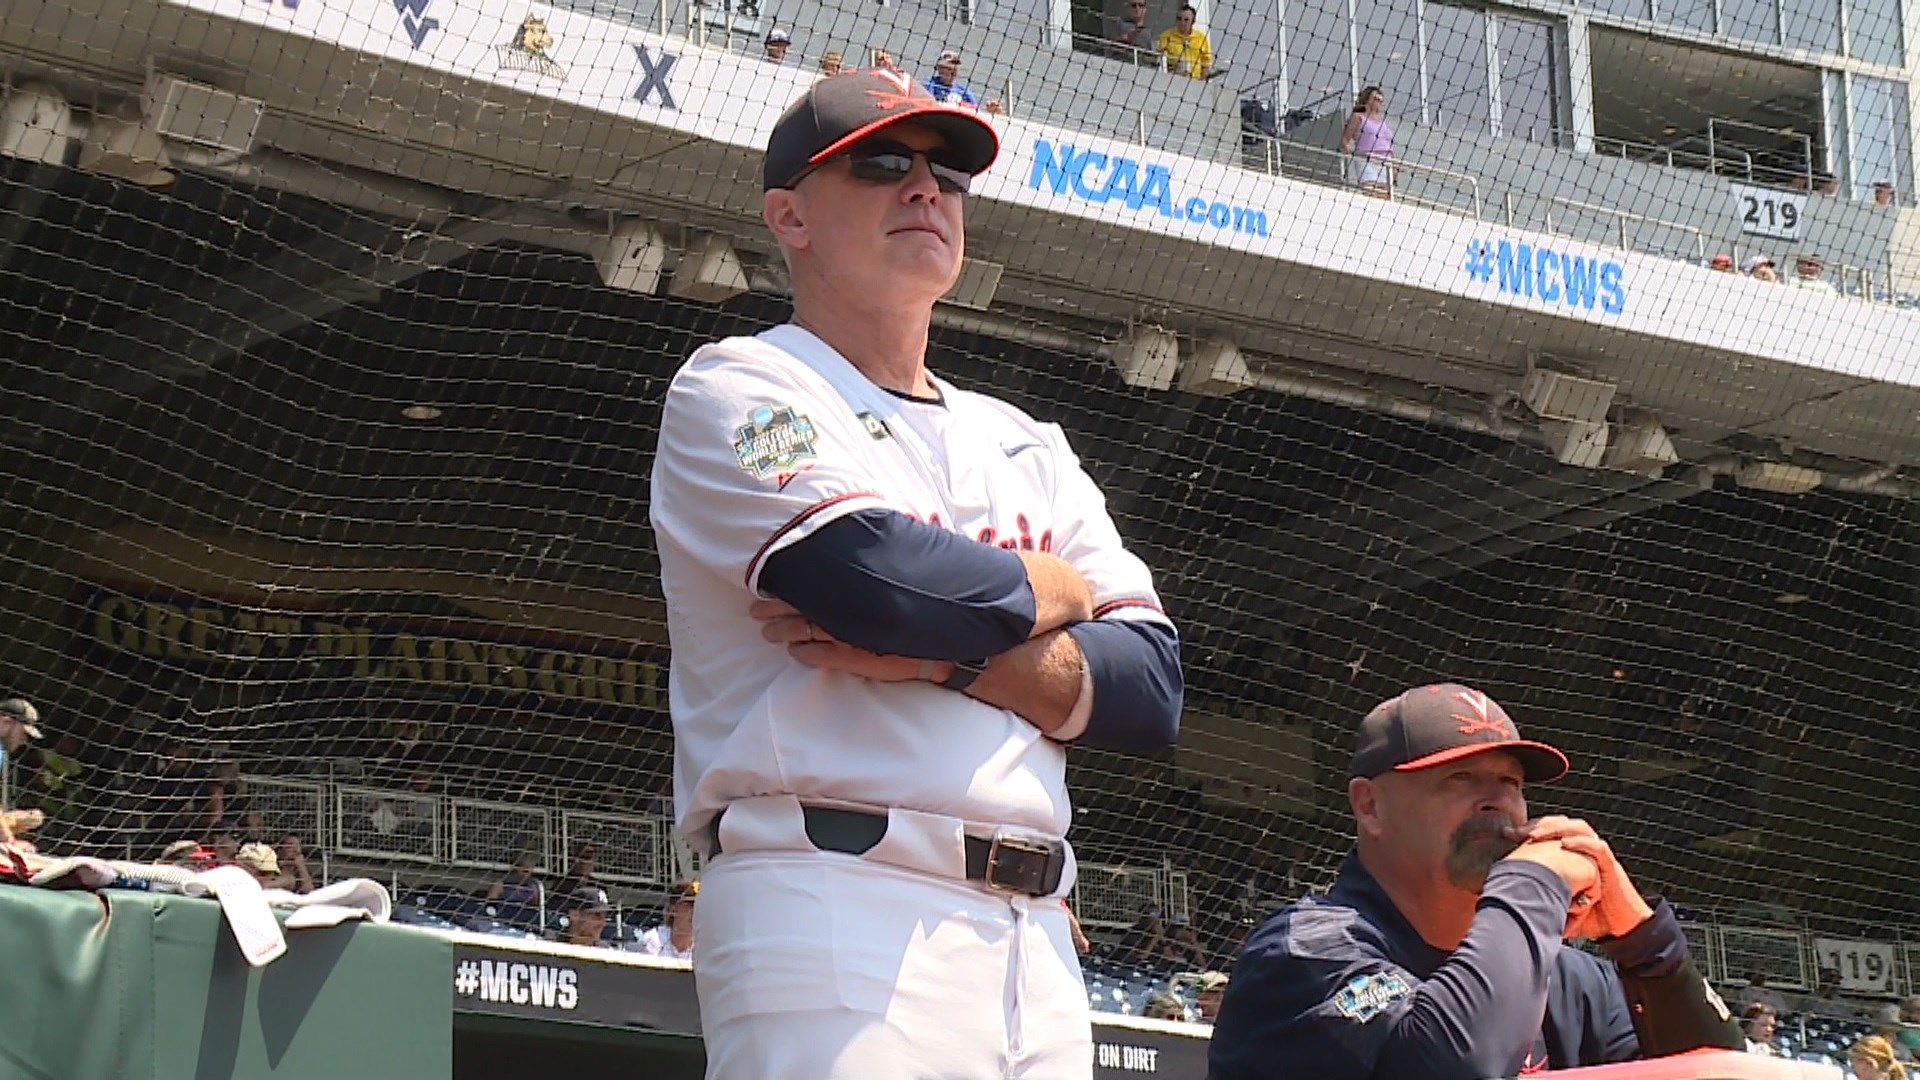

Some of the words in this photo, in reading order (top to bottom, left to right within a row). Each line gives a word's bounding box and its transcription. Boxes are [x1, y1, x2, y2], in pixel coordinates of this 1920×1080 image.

[634, 45, 677, 109] X
[1029, 139, 1268, 238] NCAA.com
[1744, 196, 1798, 229] 219
[1465, 238, 1626, 315] #MCWS
[93, 598, 303, 664] GREAT
[312, 620, 529, 699] PLAINS
[455, 960, 578, 1009] #MCWS
[1828, 951, 1884, 981] 119
[1099, 1043, 1120, 1068] ON
[1123, 1046, 1158, 1072] DIRT
